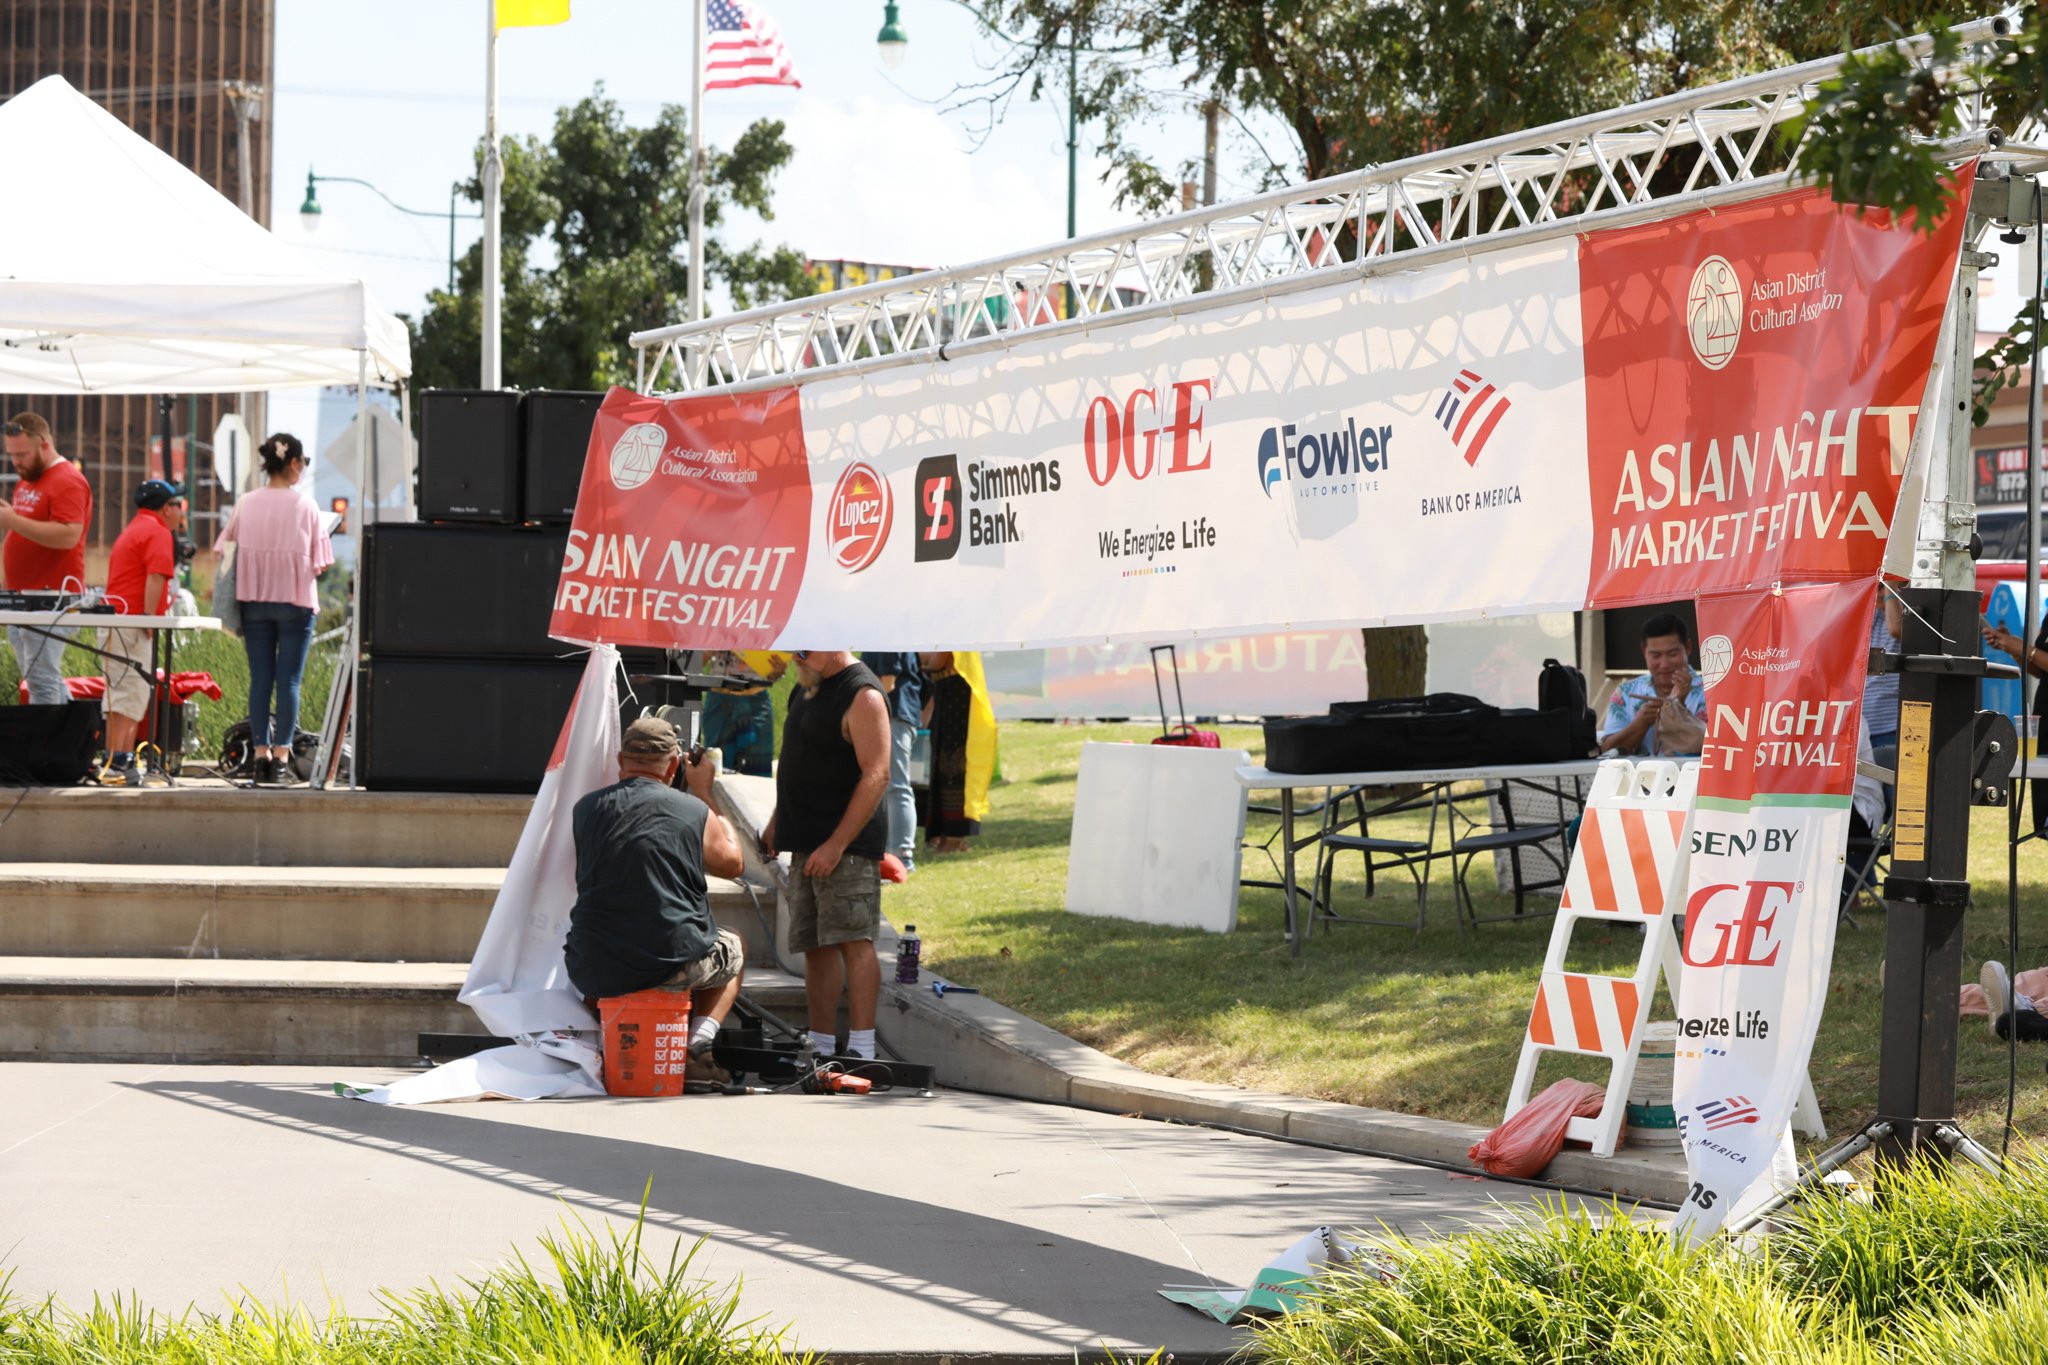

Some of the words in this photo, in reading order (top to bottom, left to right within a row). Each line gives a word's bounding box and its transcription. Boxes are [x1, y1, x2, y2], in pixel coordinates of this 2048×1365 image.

[1751, 278, 1783, 301] Asian
[1787, 267, 1826, 295] District
[1750, 303, 1796, 332] Cultural
[667, 446, 703, 463] Asian
[706, 449, 737, 464] District
[1281, 417, 1392, 480] Fowler
[661, 460, 705, 478] Cultural
[707, 469, 758, 484] Association
[968, 458, 1061, 501] Simmons
[1613, 431, 1760, 514] ASIAN
[1300, 481, 1379, 498] AUTOMOTIVE
[1422, 495, 1452, 516] BANK
[1455, 493, 1470, 512] OF
[1474, 485, 1522, 510] AMERICA
[839, 494, 881, 537] Lopez
[970, 502, 1019, 546] Bank
[1099, 530, 1119, 558] We
[1123, 524, 1175, 561] Energize
[1182, 516, 1216, 549] Life
[1608, 511, 1748, 571] MARKET
[655, 540, 795, 591] NIGHT
[642, 588, 772, 629] FESTIVAL
[1740, 647, 1766, 660] Asia
[1753, 741, 1841, 771] STIVAL
[1764, 829, 1799, 852] BY
[656, 1023, 683, 1032] MORE
[1736, 1010, 1768, 1039] Life
